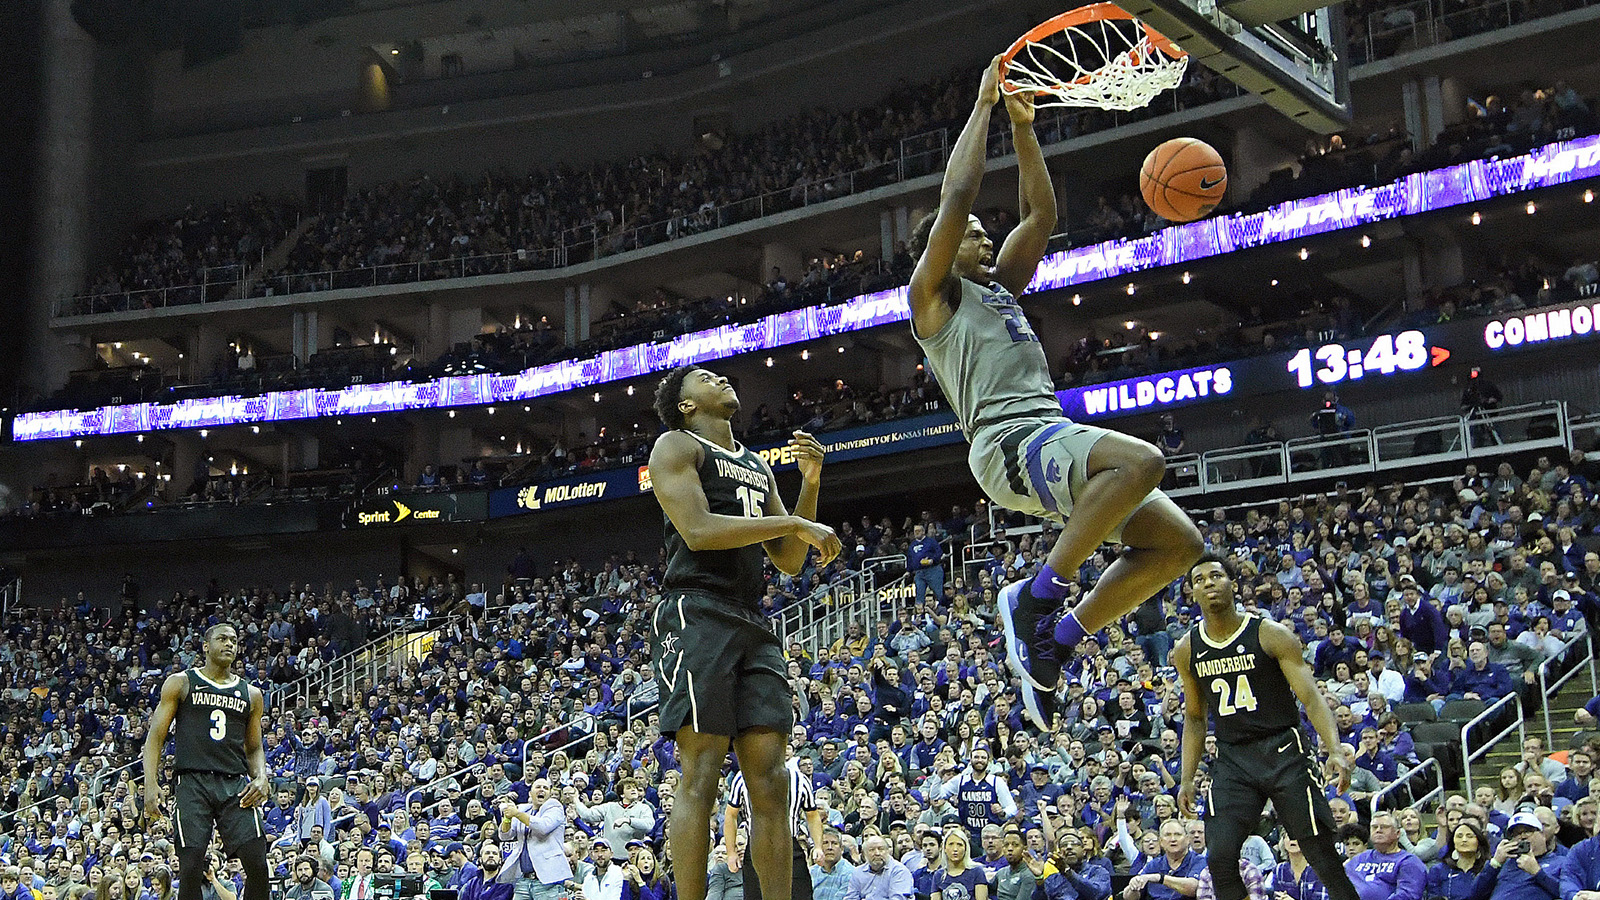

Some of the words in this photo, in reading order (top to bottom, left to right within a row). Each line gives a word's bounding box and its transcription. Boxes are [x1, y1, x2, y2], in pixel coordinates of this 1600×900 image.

[1580, 283, 1597, 296] 117
[1318, 330, 1334, 341] 117
[1287, 330, 1428, 388] 13:48
[1083, 367, 1232, 415] WILDCATS
[835, 436, 880, 451] UNIVERSITY
[891, 430, 922, 442] KANSAS
[922, 424, 953, 437] HEALTH
[622, 455, 633, 464] 116
[715, 458, 770, 493] VANDERBILT
[377, 487, 389, 495] 115
[544, 481, 607, 504] MOLottery
[736, 486, 765, 519] 15
[358, 510, 390, 526] Sprint
[413, 508, 440, 520] Center
[879, 583, 917, 604] Sprint
[1195, 653, 1256, 678] VANDERBILT
[191, 692, 247, 713] VANDERBILT
[1210, 674, 1258, 717] 24
[210, 709, 226, 741] 3
[961, 791, 992, 802] KANSAS
[968, 802, 986, 818] 30
[967, 816, 989, 828] STATE
